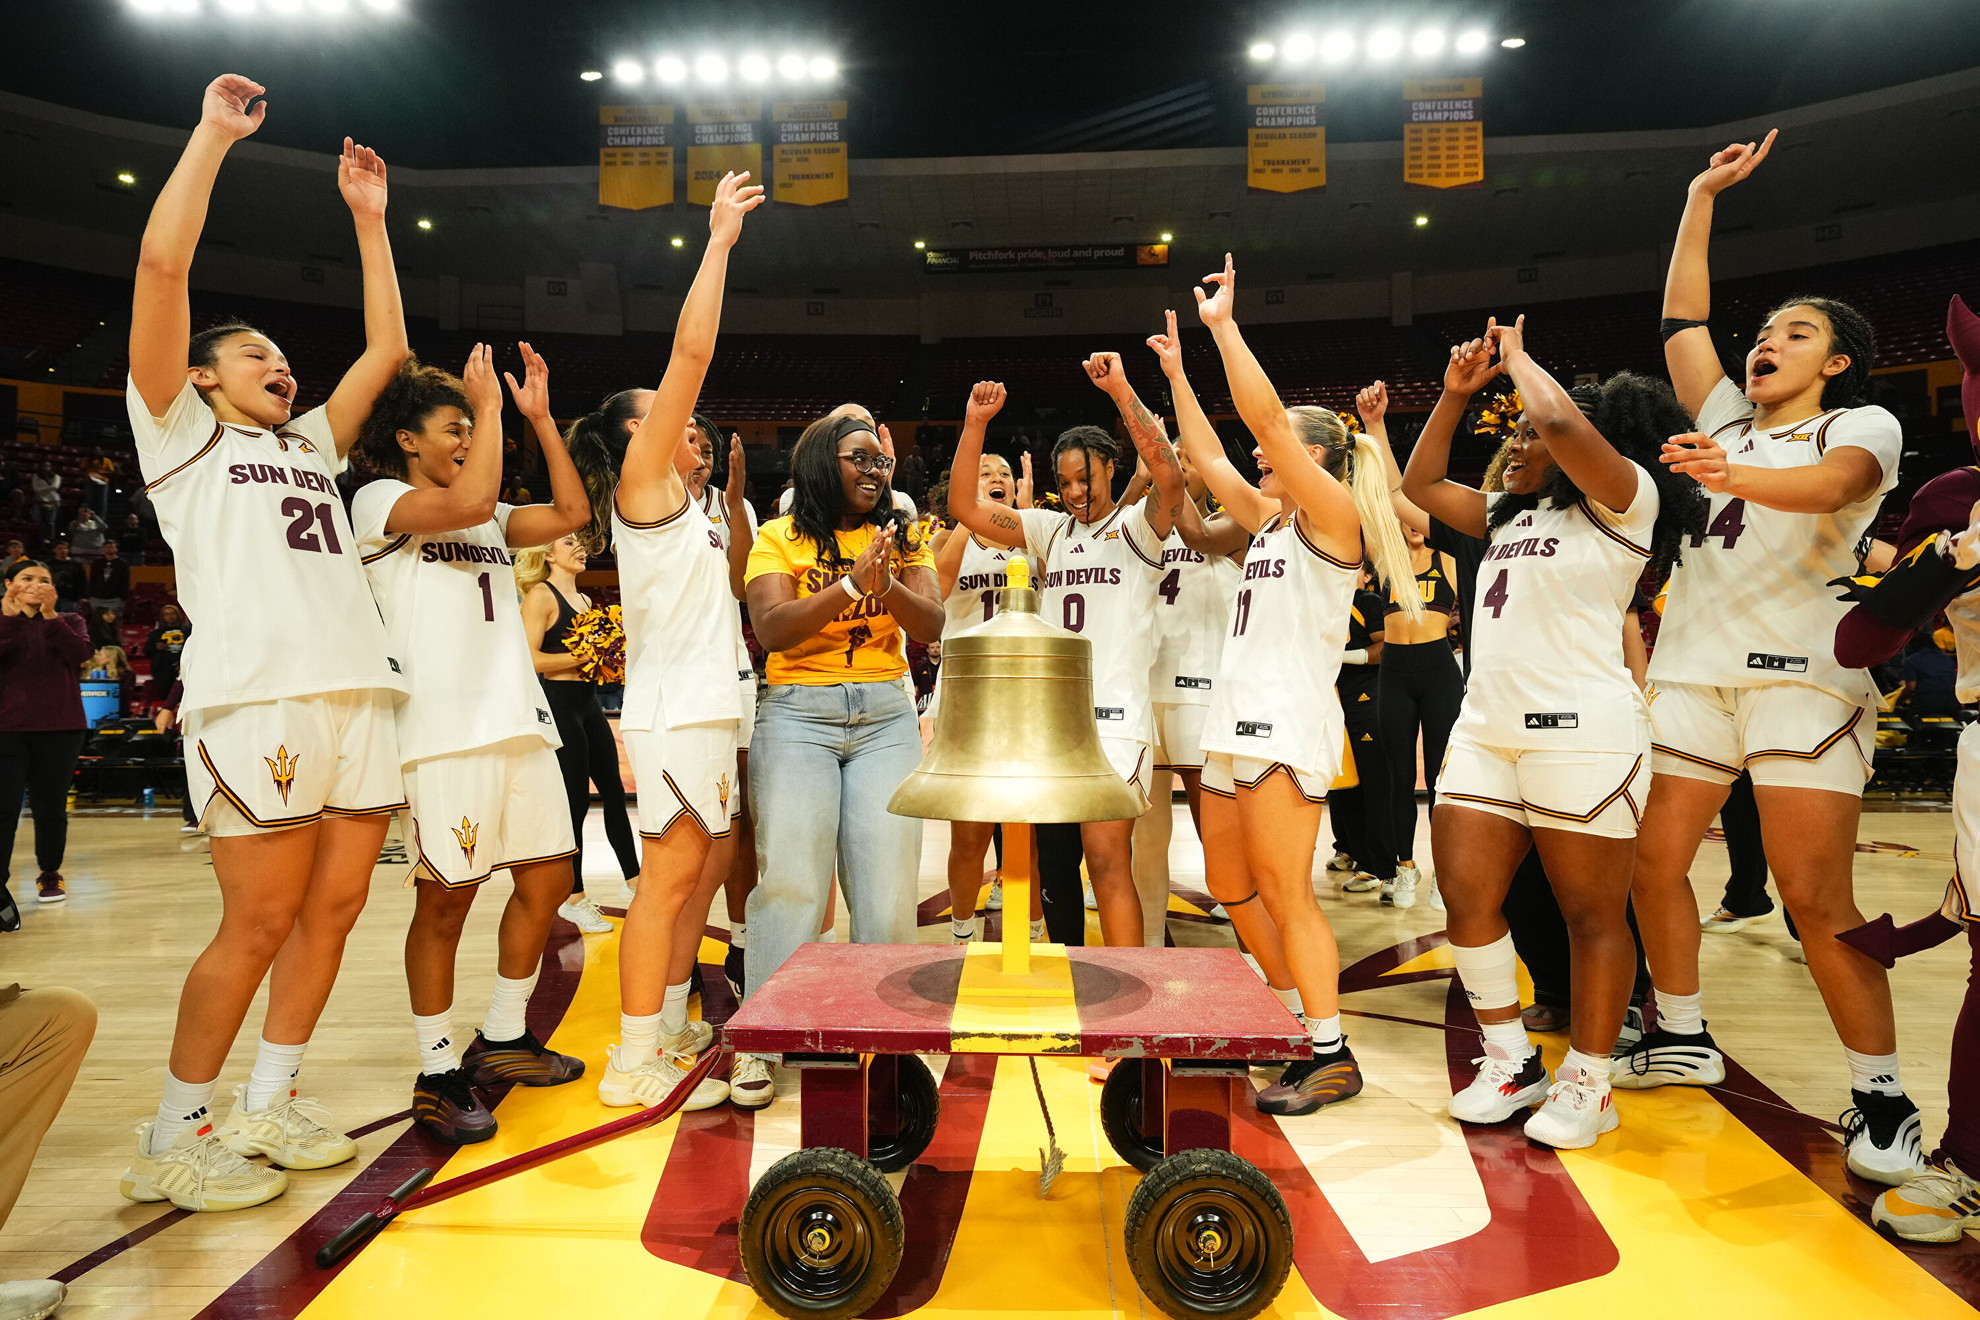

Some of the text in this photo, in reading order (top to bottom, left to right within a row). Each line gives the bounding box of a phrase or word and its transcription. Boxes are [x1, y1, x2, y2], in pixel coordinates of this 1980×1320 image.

[1256, 105, 1317, 116] CONFERENCE
[1412, 100, 1474, 110] CONFERENCE
[1256, 116, 1317, 127] CHAMPIONS
[1412, 110, 1474, 121] CHAMPIONS
[607, 126, 665, 135] CONFERENCE
[695, 123, 753, 133] CONFERENCE
[781, 121, 839, 132] CONFERENCE
[607, 135, 665, 145] CHAMPIONS
[695, 133, 753, 144] CHAMPIONS
[781, 132, 839, 142] CHAMPIONS
[694, 170, 721, 180] 2024
[970, 248, 1124, 261] Pitchfork pride, loud and proud
[229, 464, 289, 484] SUN
[281, 497, 342, 554] 21
[1494, 538, 1560, 560] DEVILS
[1066, 567, 1121, 585] DEVILS
[1245, 559, 1286, 581] EVILS
[959, 574, 989, 590] SUN
[1159, 569, 1180, 605] 4
[478, 572, 494, 622] 1
[1483, 569, 1509, 619] 4
[981, 590, 1000, 622] 1
[1063, 593, 1085, 633] 0
[1233, 589, 1252, 637] 11
